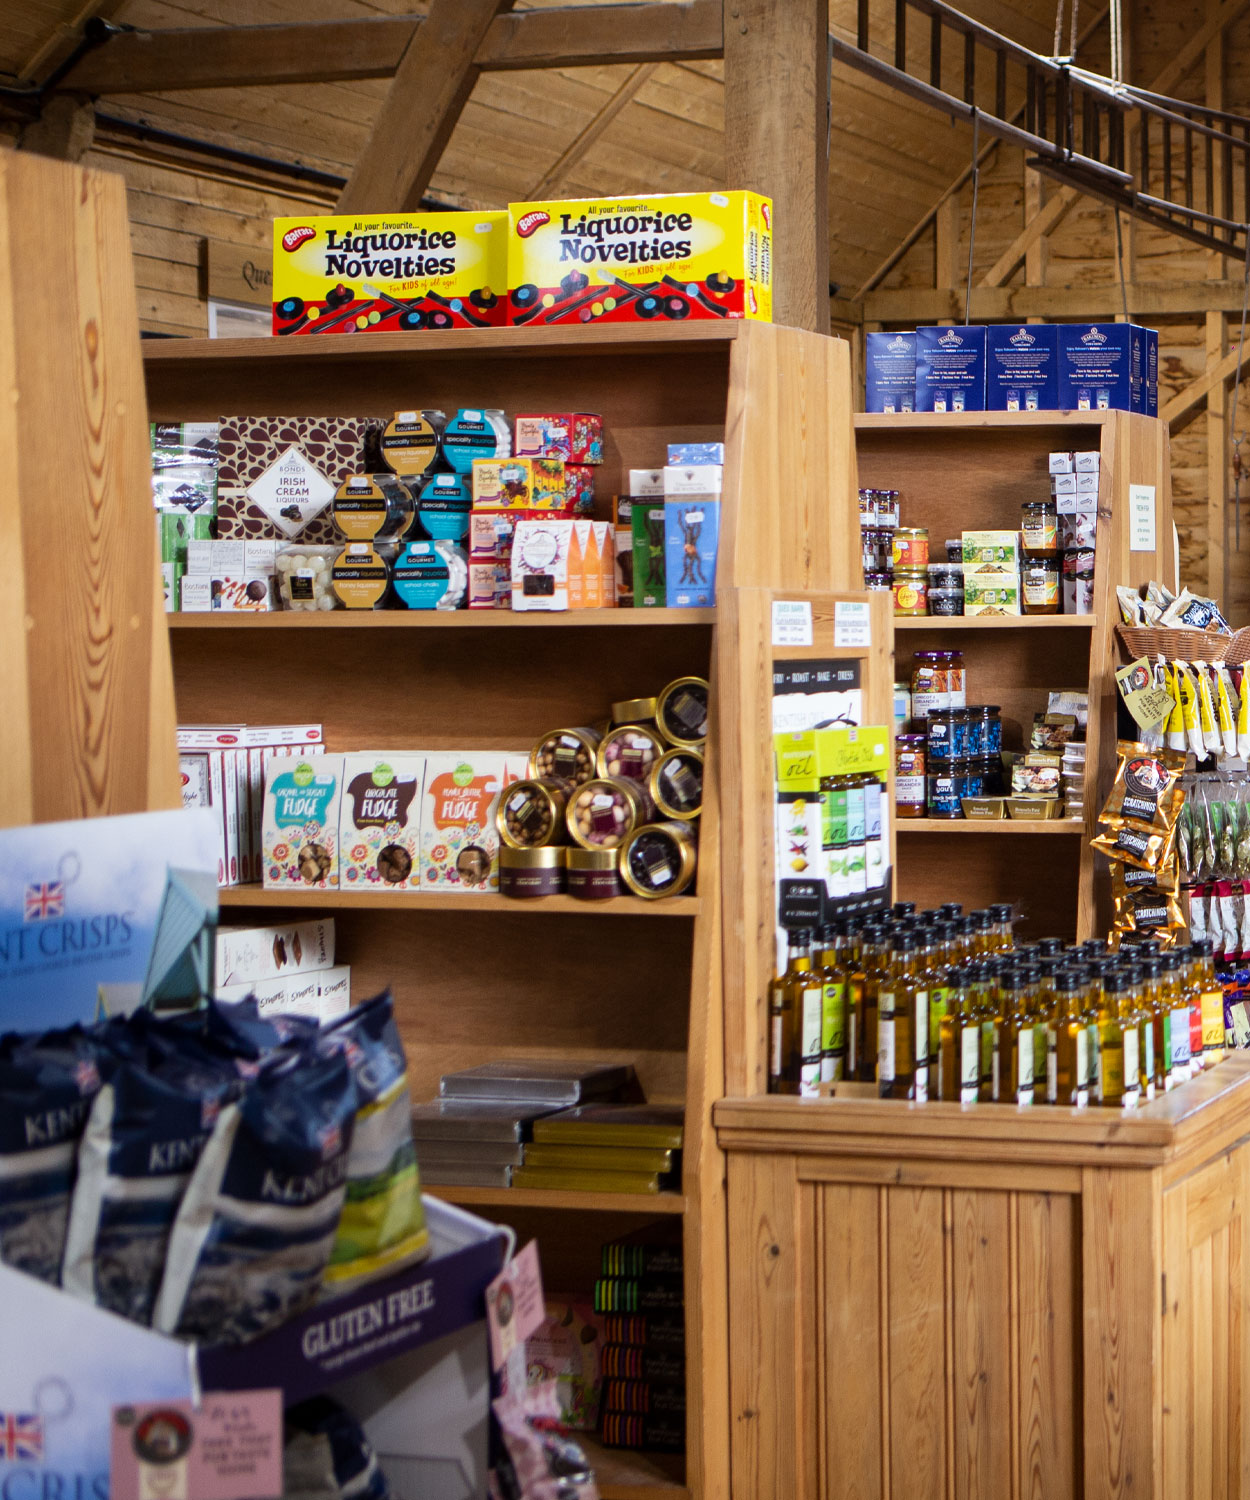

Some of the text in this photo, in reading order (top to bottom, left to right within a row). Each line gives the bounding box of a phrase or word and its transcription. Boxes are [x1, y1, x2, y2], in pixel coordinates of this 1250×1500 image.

[588, 206, 615, 215] All your
[364, 223, 380, 231] your
[560, 212, 693, 242] Liquorice
[325, 229, 456, 259] Liquorice
[560, 240, 691, 263] Novelties
[325, 254, 455, 278] Novelties
[637, 265, 654, 275] KIDS
[242, 261, 273, 291] Que
[402, 280, 419, 291] KIDS
[838, 671, 854, 680] DRESS
[283, 798, 319, 817] FUDGE
[362, 799, 399, 818] FUDGE
[442, 801, 478, 820] FUDGE
[1124, 797, 1156, 812] SCRATCHINGS
[1135, 907, 1167, 919] SCRATCHINGS
[38, 911, 135, 957] CRISPS
[302, 1299, 384, 1360] GLUTEN
[386, 1278, 436, 1325] FREE
